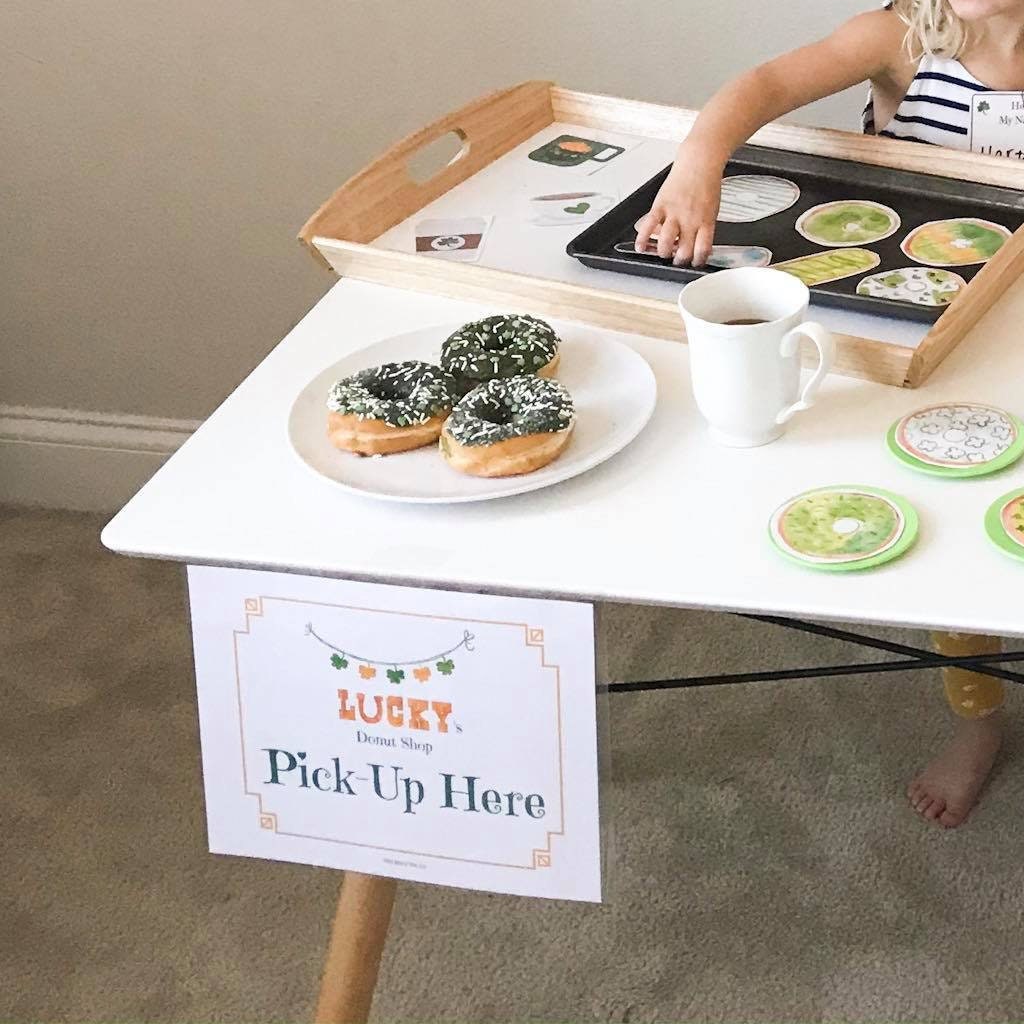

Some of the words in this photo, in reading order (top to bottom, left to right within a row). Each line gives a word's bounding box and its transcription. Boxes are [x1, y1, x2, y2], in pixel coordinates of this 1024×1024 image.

[1000, 115, 1013, 126] My
[356, 731, 396, 747] Donut
[400, 737, 433, 756] Shop
[260, 747, 425, 815] Pick-Up
[439, 772, 546, 820] Here
